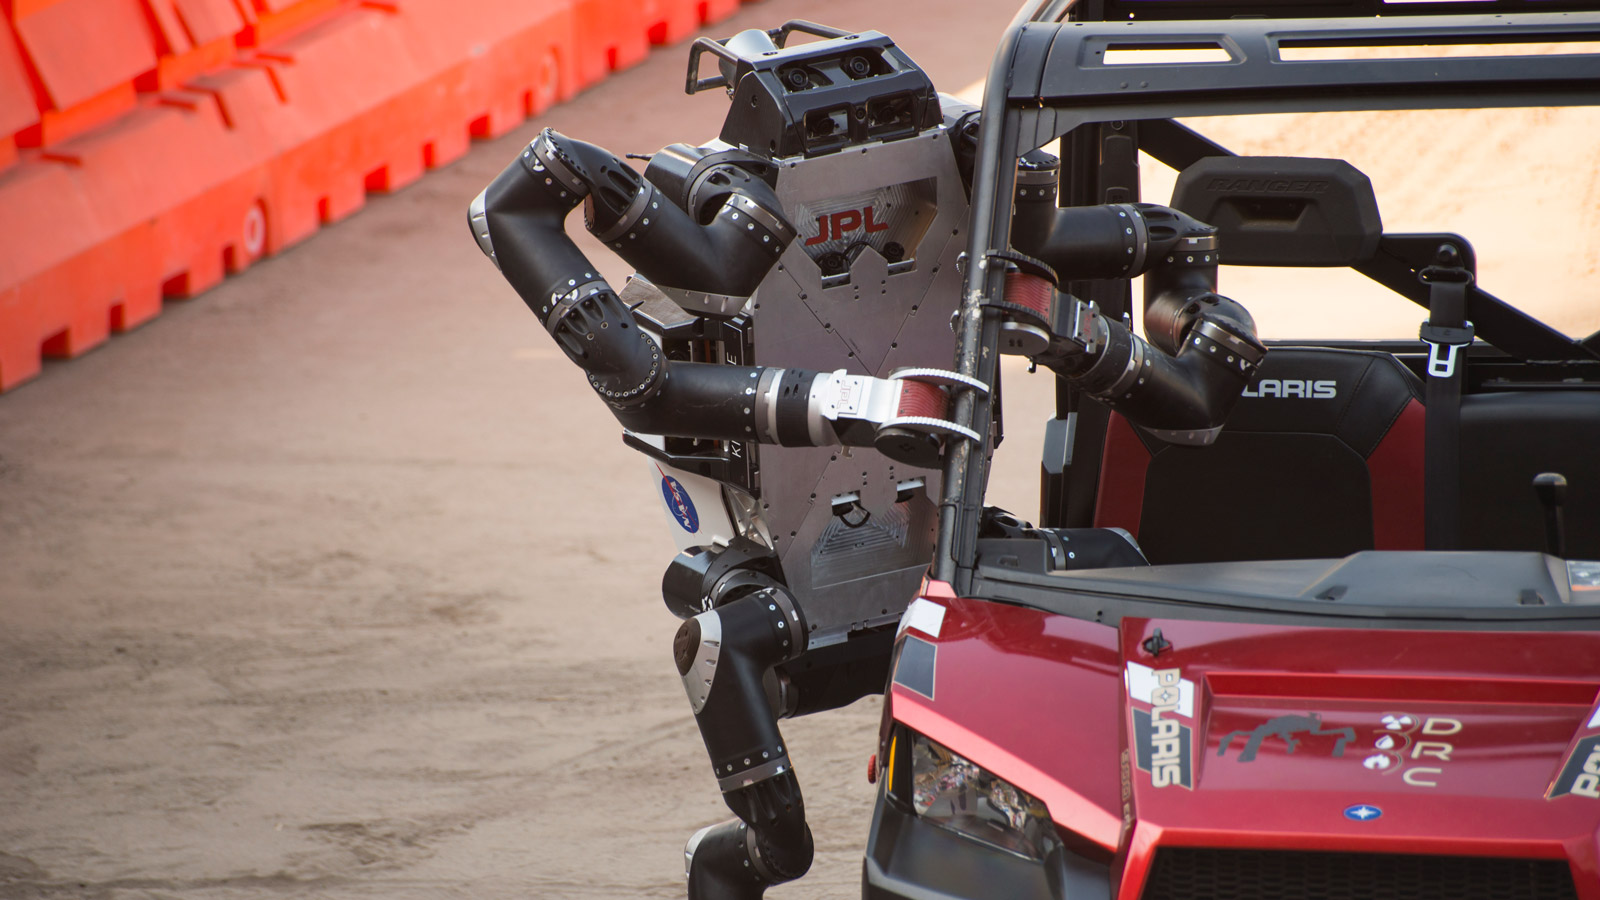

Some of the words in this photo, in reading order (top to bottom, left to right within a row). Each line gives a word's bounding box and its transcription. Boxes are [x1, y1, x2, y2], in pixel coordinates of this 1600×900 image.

[1206, 177, 1329, 194] RANGER
[805, 206, 888, 246] JPL
[1241, 379, 1337, 399] LARIS
[1151, 667, 1180, 788] POLARIS
